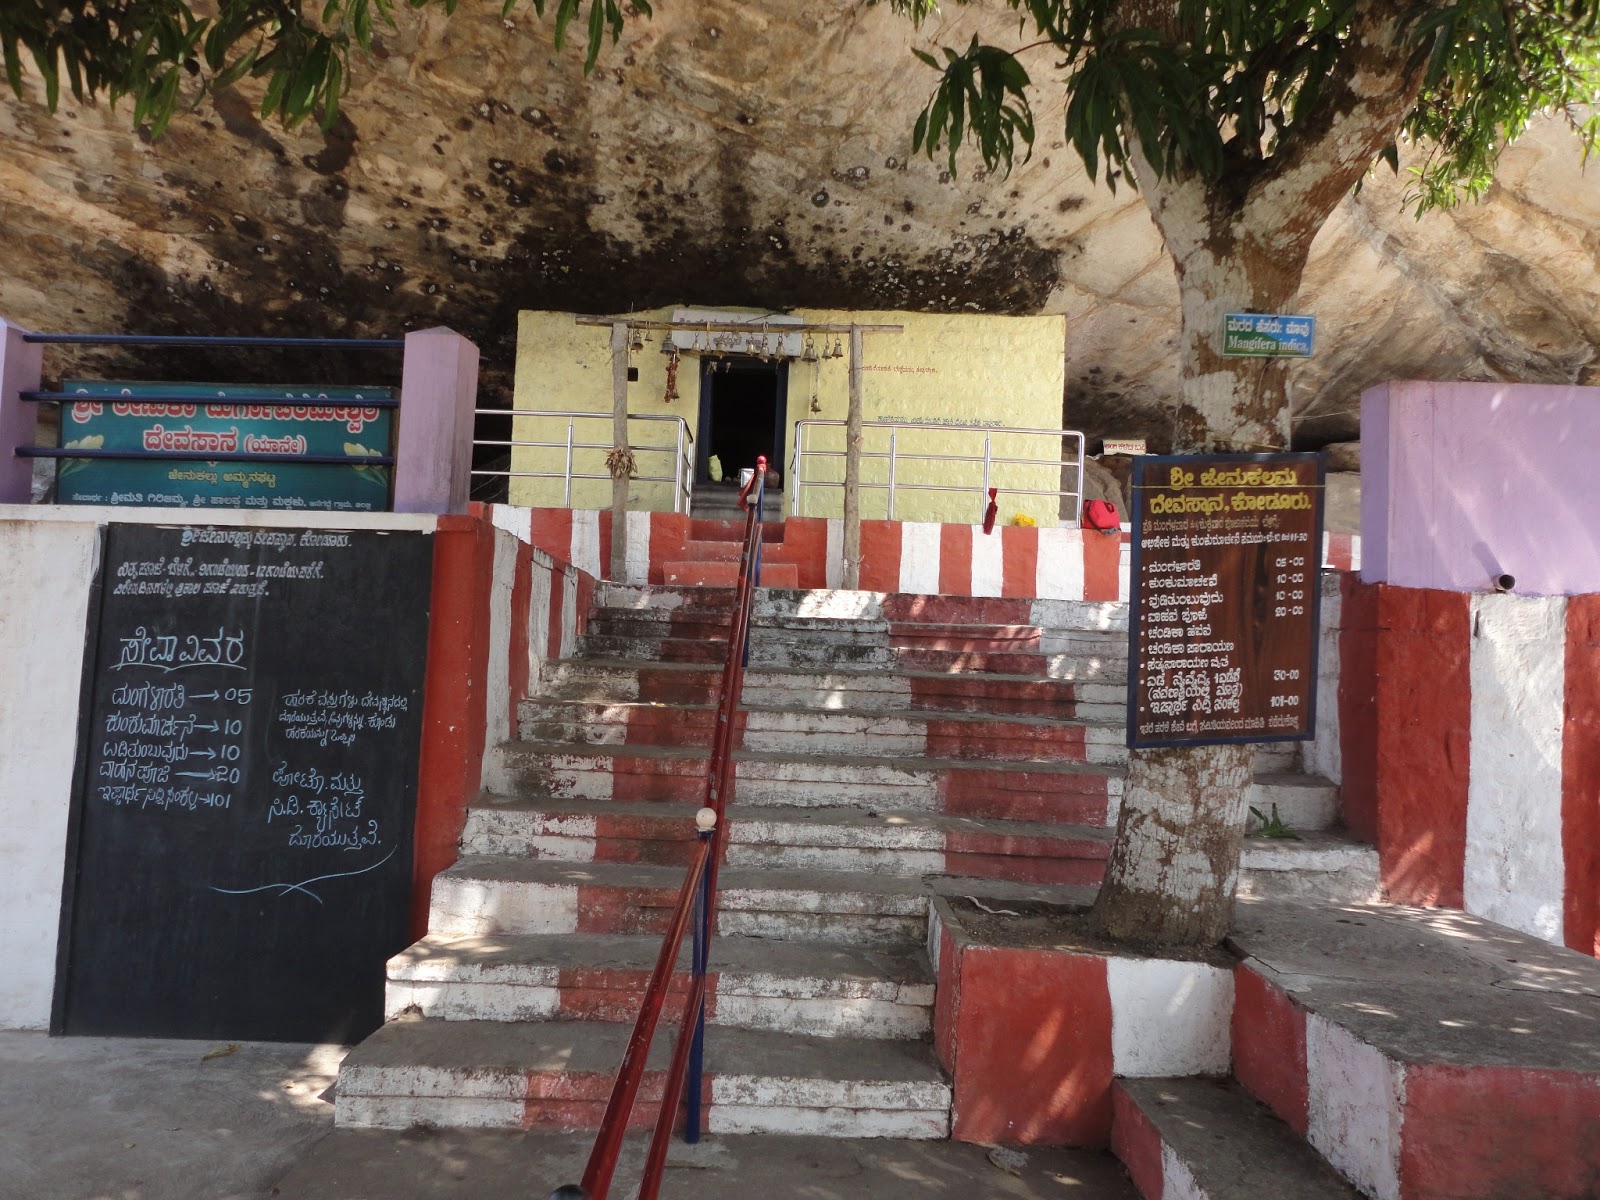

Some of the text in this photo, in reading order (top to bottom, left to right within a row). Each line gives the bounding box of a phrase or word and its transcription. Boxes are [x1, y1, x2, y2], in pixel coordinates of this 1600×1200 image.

[1228, 336, 1276, 352] Mangifera
[1170, 466, 1194, 491] ಶ್ರೀ
[1149, 559, 1202, 574] ಮಂಗಳಾರತಿ
[112, 681, 185, 712] ಮಂಗಳಾರತಿ
[225, 688, 253, 705] 05
[224, 719, 242, 735] 10
[221, 744, 240, 761] 10
[215, 765, 241, 784] 20
[331, 771, 364, 796] ಮತ್ತು
